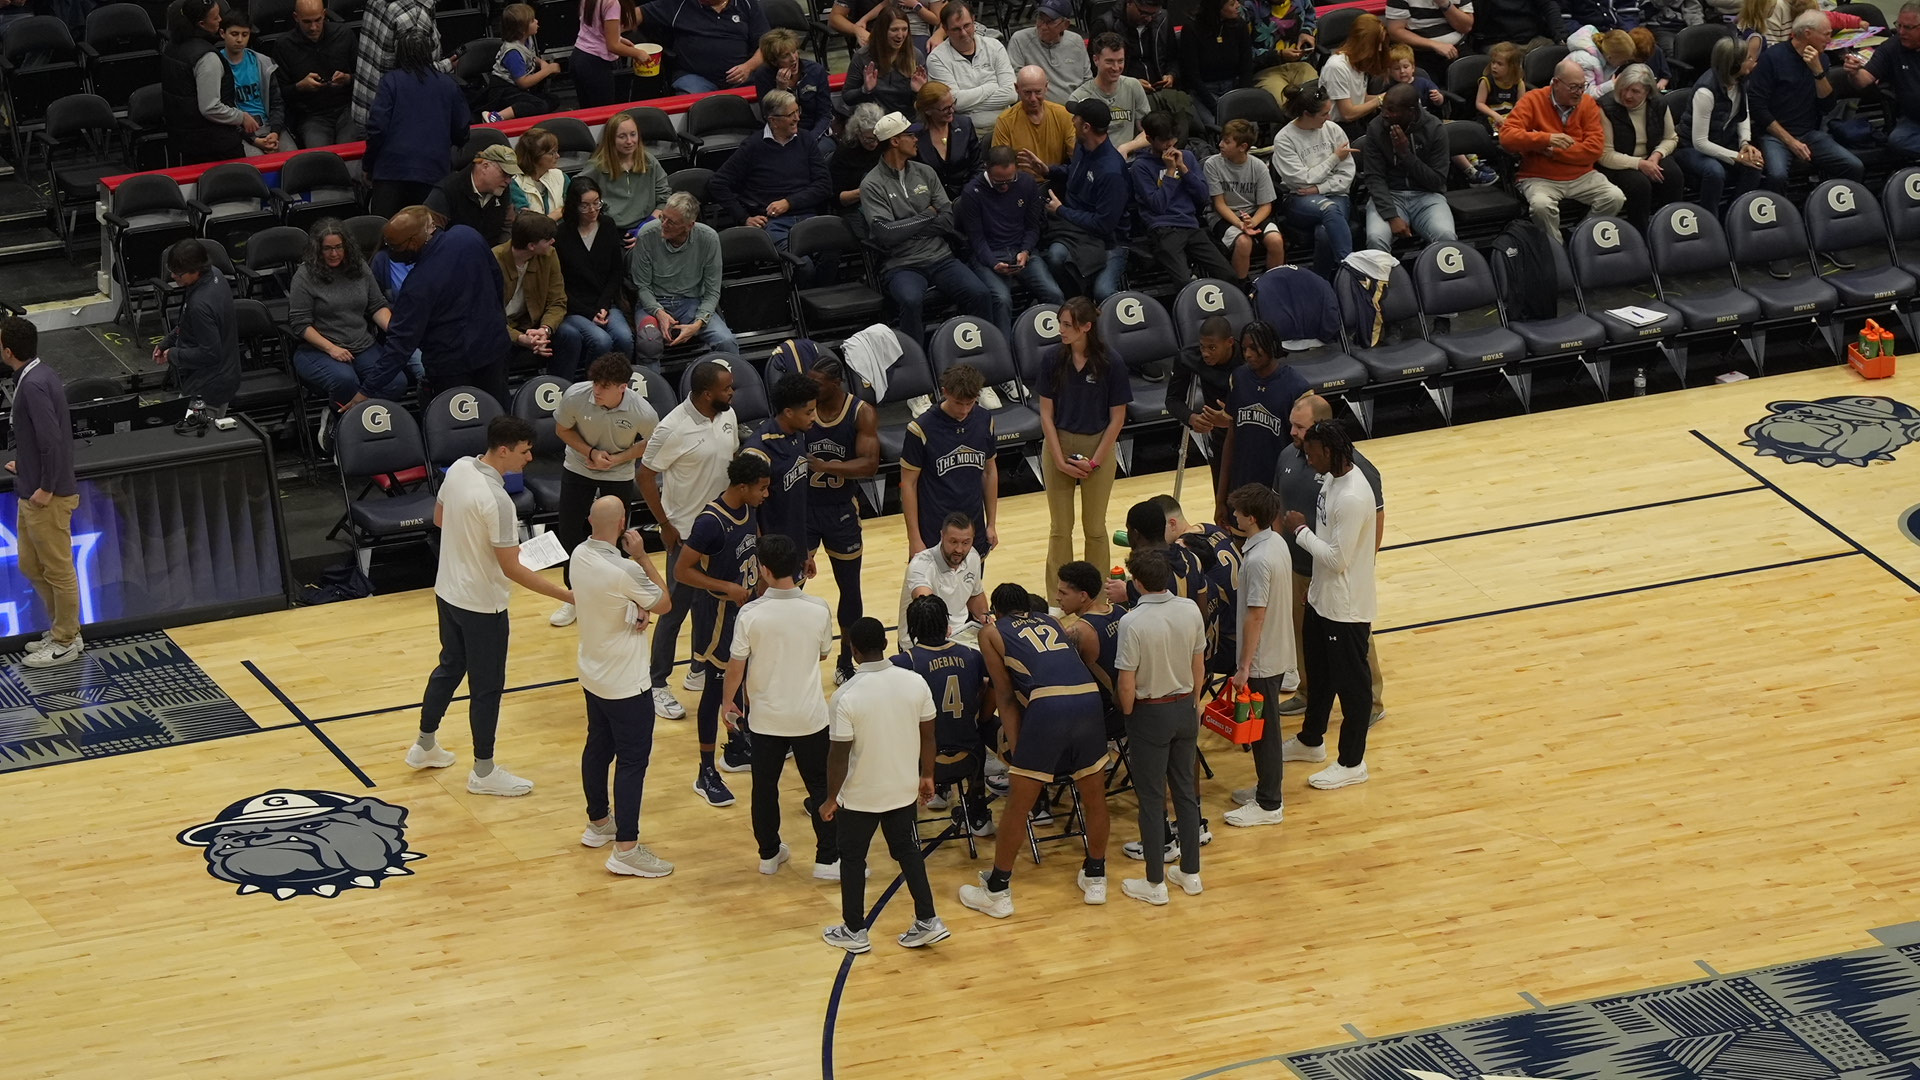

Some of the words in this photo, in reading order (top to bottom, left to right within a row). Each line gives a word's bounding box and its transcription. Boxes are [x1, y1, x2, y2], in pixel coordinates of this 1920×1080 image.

[1749, 196, 1777, 224] G
[1827, 185, 1856, 212] G
[1593, 221, 1620, 248] G
[1671, 208, 1699, 236] G
[1437, 246, 1465, 274] G
[1196, 284, 1225, 312] G
[1793, 303, 1816, 312] HOYAS
[1116, 298, 1145, 325] G
[1716, 314, 1739, 323] HOYAS
[953, 322, 983, 350] G
[1034, 310, 1061, 339] G
[1639, 327, 1662, 336] HOYAS
[1482, 352, 1504, 361] HOYAS
[1560, 340, 1583, 349] HOYAS
[1402, 366, 1425, 375] HOYAS
[1323, 379, 1346, 388] HOYAS
[449, 392, 479, 421] G
[534, 382, 563, 411] G
[362, 405, 392, 433] G
[1238, 409, 1251, 423] THE
[1252, 410, 1280, 432] MOUNT
[997, 432, 1020, 441] HOYAS
[810, 443, 821, 453] THE
[822, 443, 845, 456] MOUNT
[938, 455, 956, 473] THE
[956, 452, 984, 467] MOUNT
[784, 468, 798, 487] THE
[400, 517, 424, 527] HOYAS
[740, 554, 759, 590] 13
[1018, 624, 1069, 653] 12
[928, 656, 965, 673] ADEBAYO
[942, 674, 964, 718] 4
[262, 796, 289, 807] G
